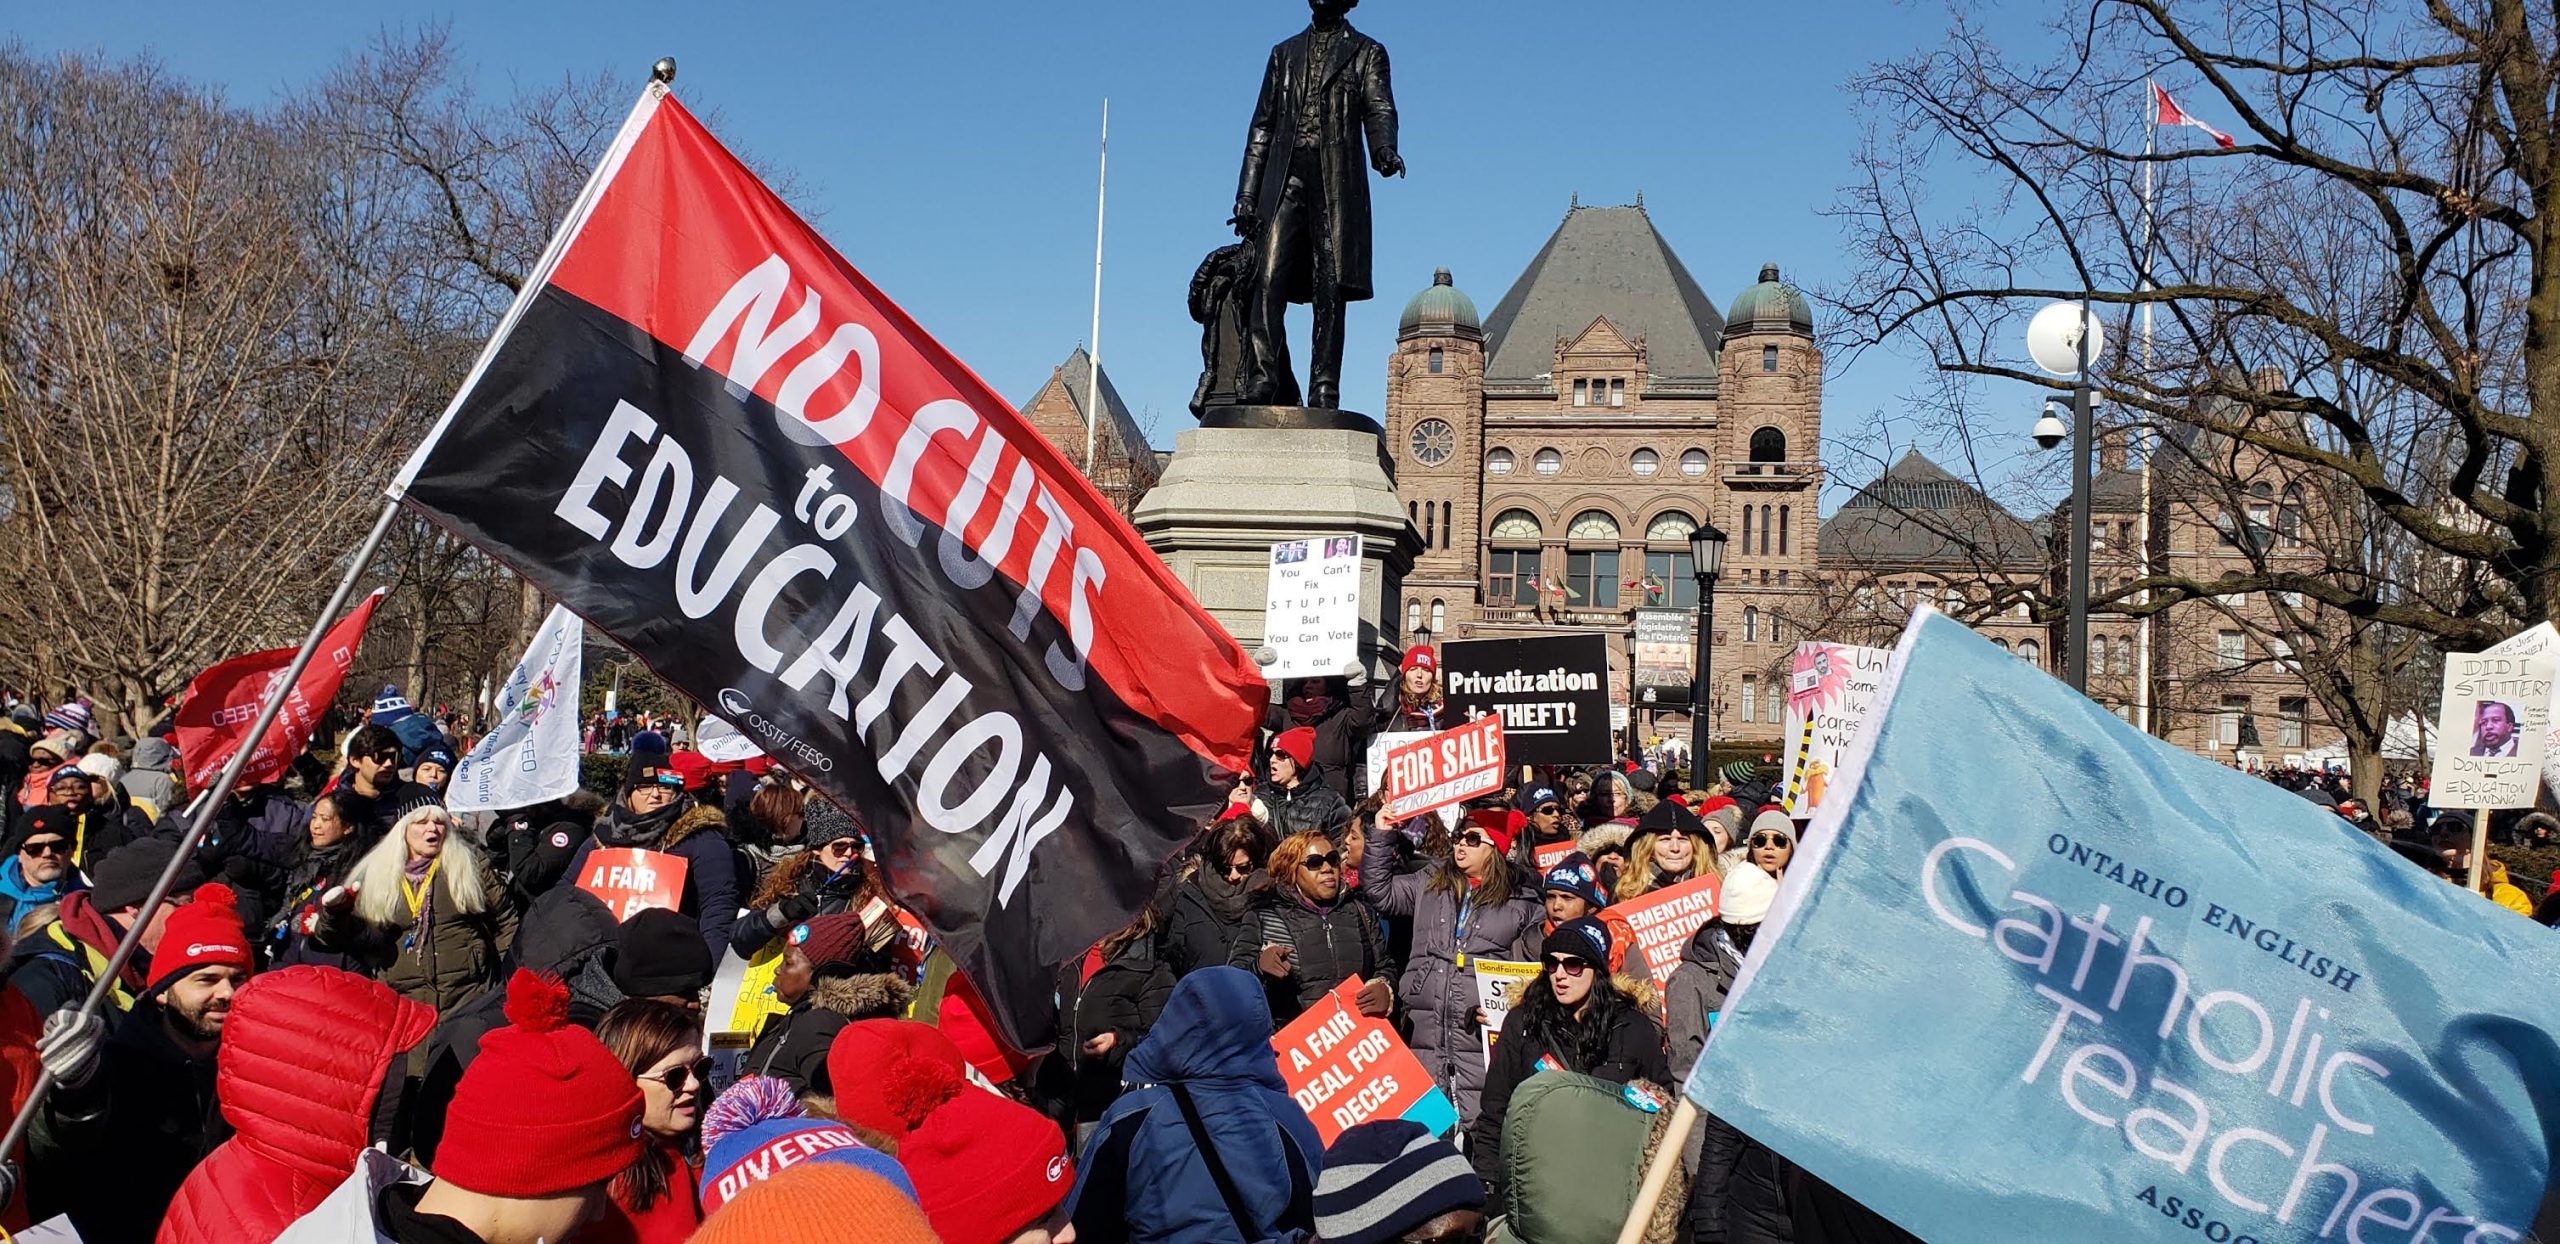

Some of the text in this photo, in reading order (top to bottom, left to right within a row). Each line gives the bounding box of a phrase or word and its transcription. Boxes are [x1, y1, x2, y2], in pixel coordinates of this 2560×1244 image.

[681, 252, 1106, 692] NO CUTS
[795, 463, 858, 541] to
[1280, 564, 1351, 578] You Can't
[1304, 580, 1319, 589] Fix
[1301, 615, 1320, 625] But
[1638, 622, 1682, 632] législative
[1639, 612, 1685, 622] Assemblée
[1269, 630, 1354, 643] You Can Vote
[1638, 632, 1649, 641] de
[554, 398, 1074, 910] EDUCATION
[2462, 658, 2532, 677] DID I
[1449, 667, 1598, 695] Privatization
[2455, 679, 2552, 698] STUTTER?
[1492, 702, 1577, 728] THEFT!
[1843, 694, 1867, 715] like
[749, 714, 833, 772] OSSTF/FEESO
[1390, 723, 1500, 796] FOR SALE
[2498, 763, 2533, 775] CUT
[2446, 779, 2528, 794] EDUCATION
[590, 865, 657, 892] A FAIR
[1626, 887, 1713, 931] EMENTARY
[2047, 833, 2362, 993] ONTARIO ENGLISH
[1636, 908, 1713, 951] DUCATION
[1921, 836, 2391, 1136] Catholic
[1289, 1010, 1357, 1073] A FAIR
[1294, 1028, 1391, 1114] DEAL FOR
[718, 1130, 866, 1204] RIVERD
